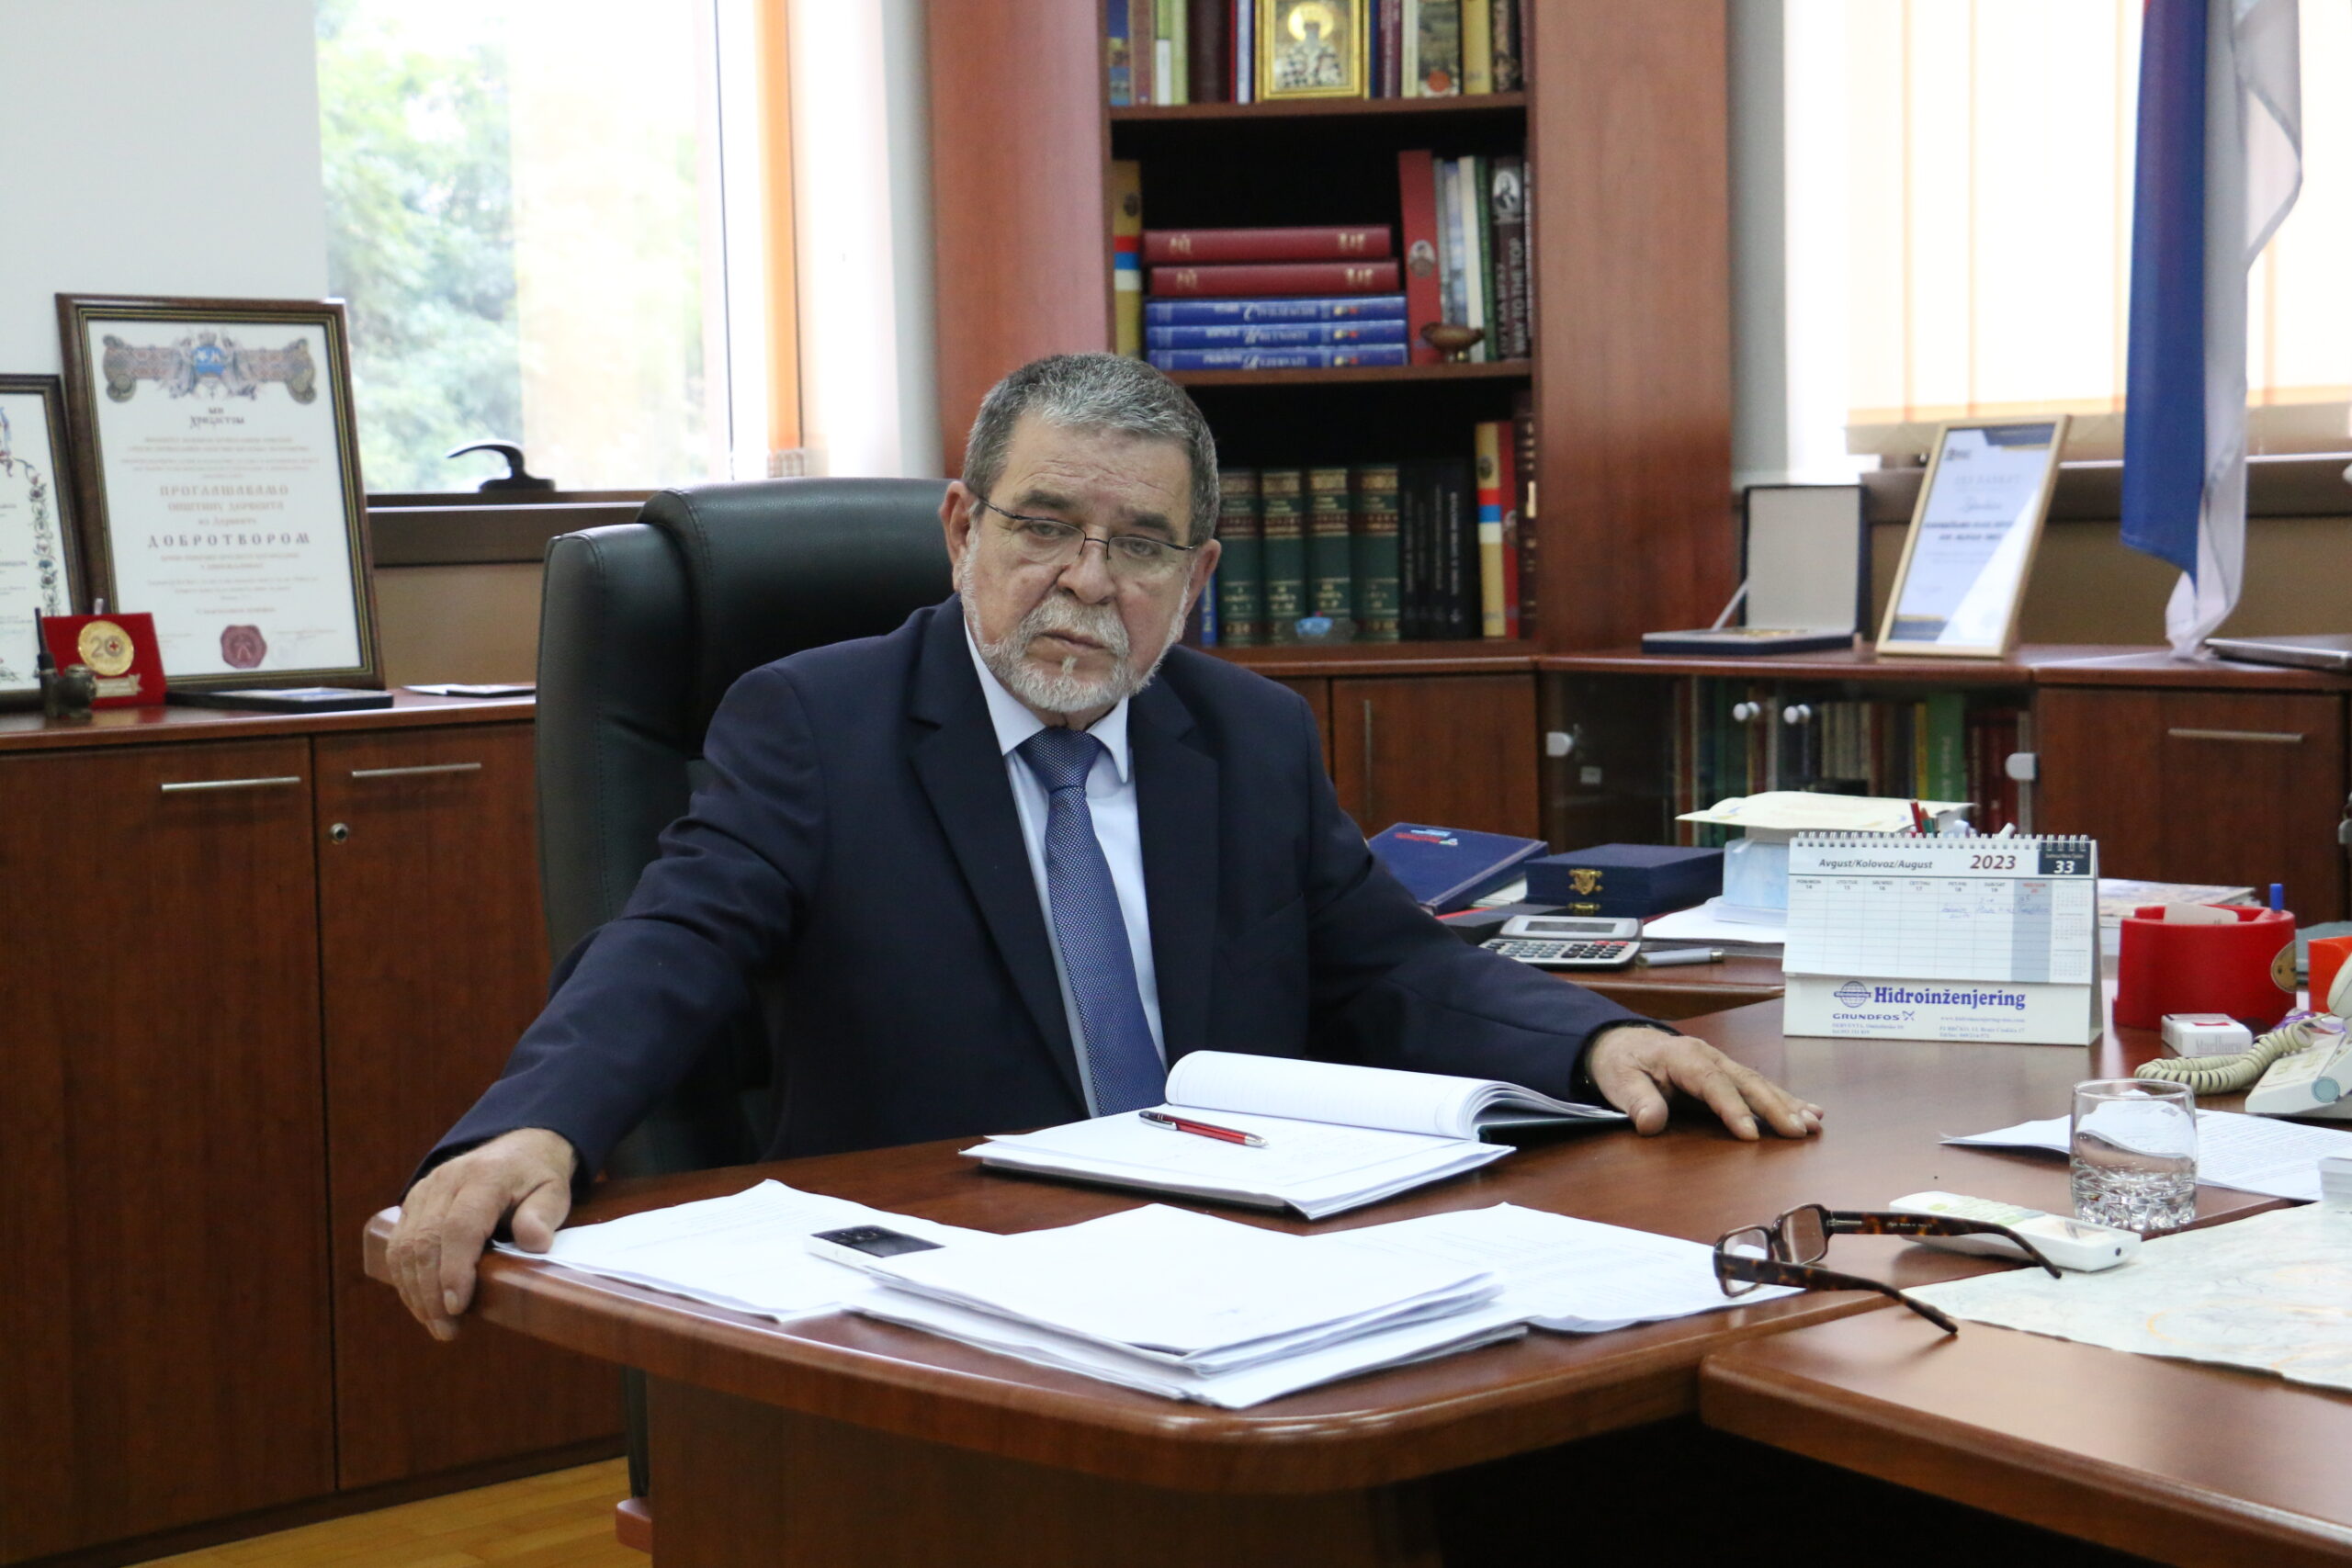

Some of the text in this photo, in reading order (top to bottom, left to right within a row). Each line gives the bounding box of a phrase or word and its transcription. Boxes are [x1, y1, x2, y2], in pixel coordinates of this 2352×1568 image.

[148, 532, 311, 548] ДОБРОТВОРОМ
[1970, 854, 2017, 870] 2023
[2053, 860, 2075, 874] 33
[1874, 987, 2026, 1010] Hidroinženjering
[1832, 1012, 1900, 1021] GRUNDFOS
